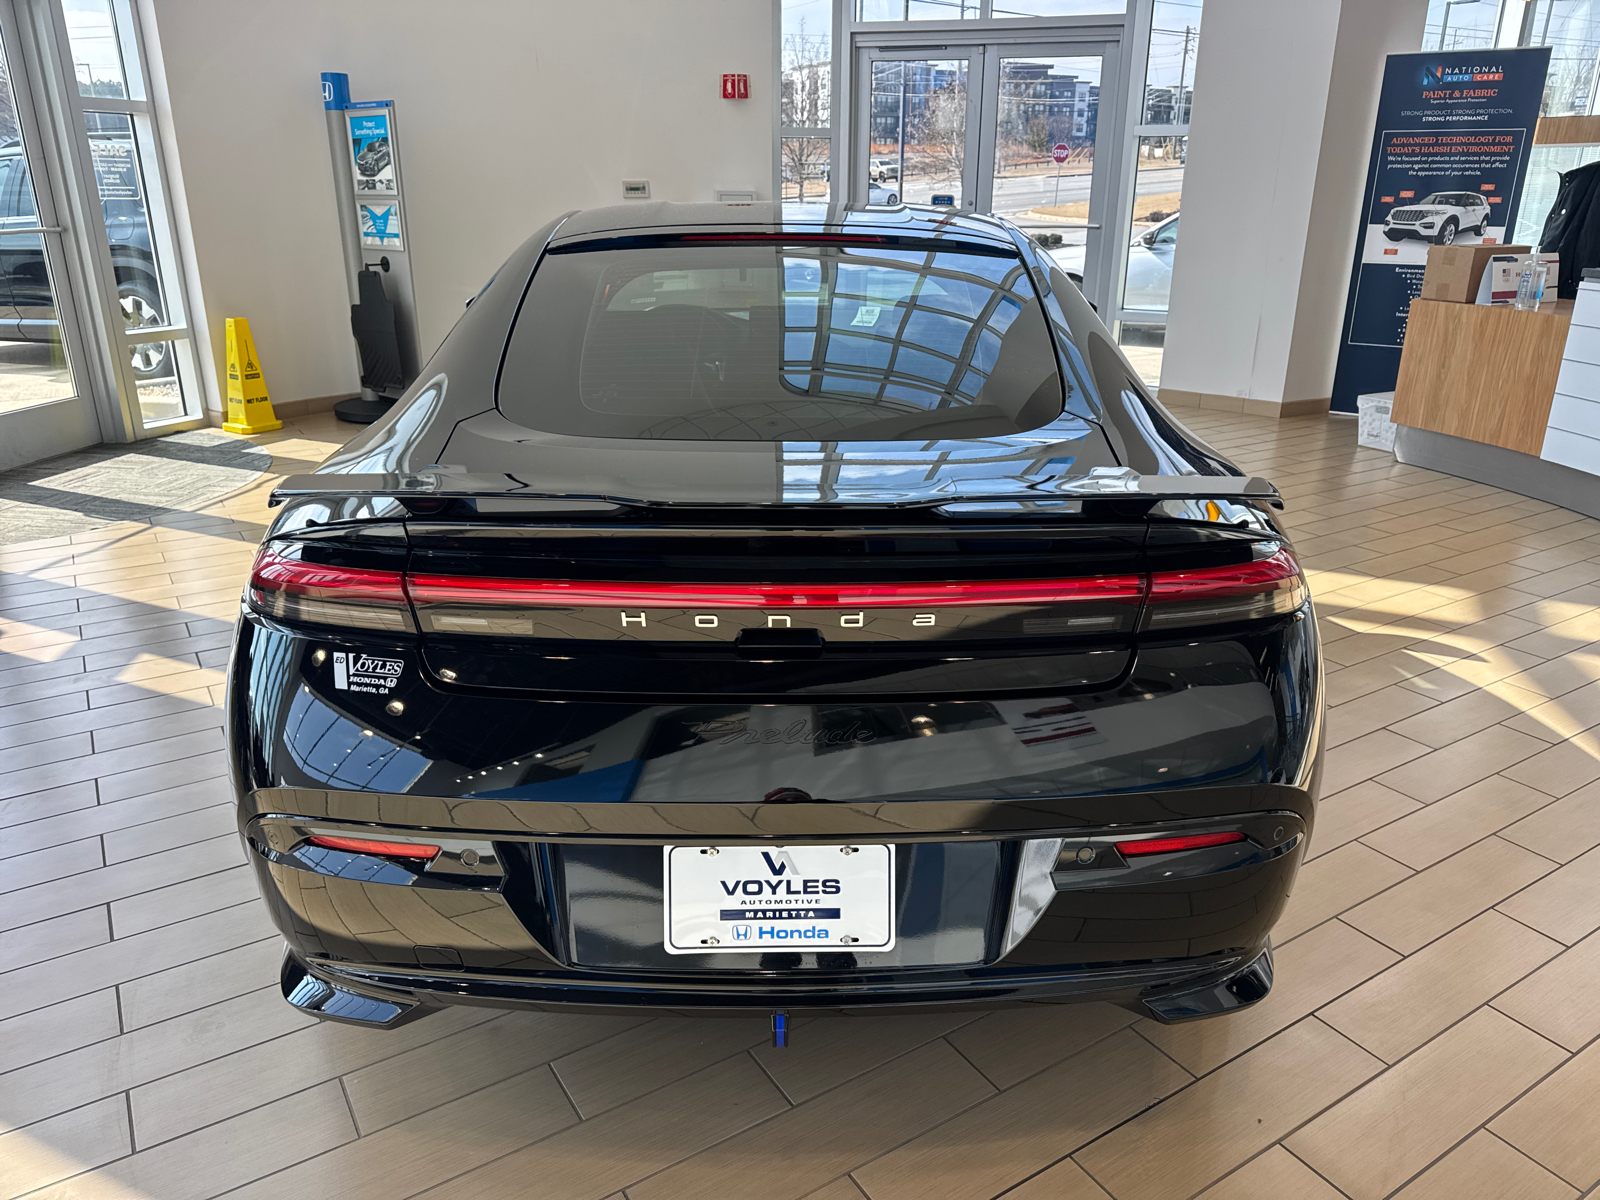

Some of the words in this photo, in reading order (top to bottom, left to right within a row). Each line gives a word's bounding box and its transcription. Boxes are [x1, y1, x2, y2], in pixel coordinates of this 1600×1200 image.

[1445, 66, 1503, 74] NATIONAL
[1422, 90, 1451, 99] PAINT
[1462, 89, 1498, 97] FABRIC
[1451, 145, 1515, 153] ENVIRONMENT
[620, 610, 936, 628] Honda
[335, 656, 345, 664] ED
[348, 653, 402, 676] VOYLES
[349, 676, 385, 685] HONDA
[350, 684, 377, 694] Marietta,
[681, 718, 876, 745] Prelude
[720, 878, 841, 896] VOYLES
[740, 898, 821, 906] AUTOMOTIVE
[745, 910, 816, 919] MARIETTA
[758, 926, 829, 940] Honda
